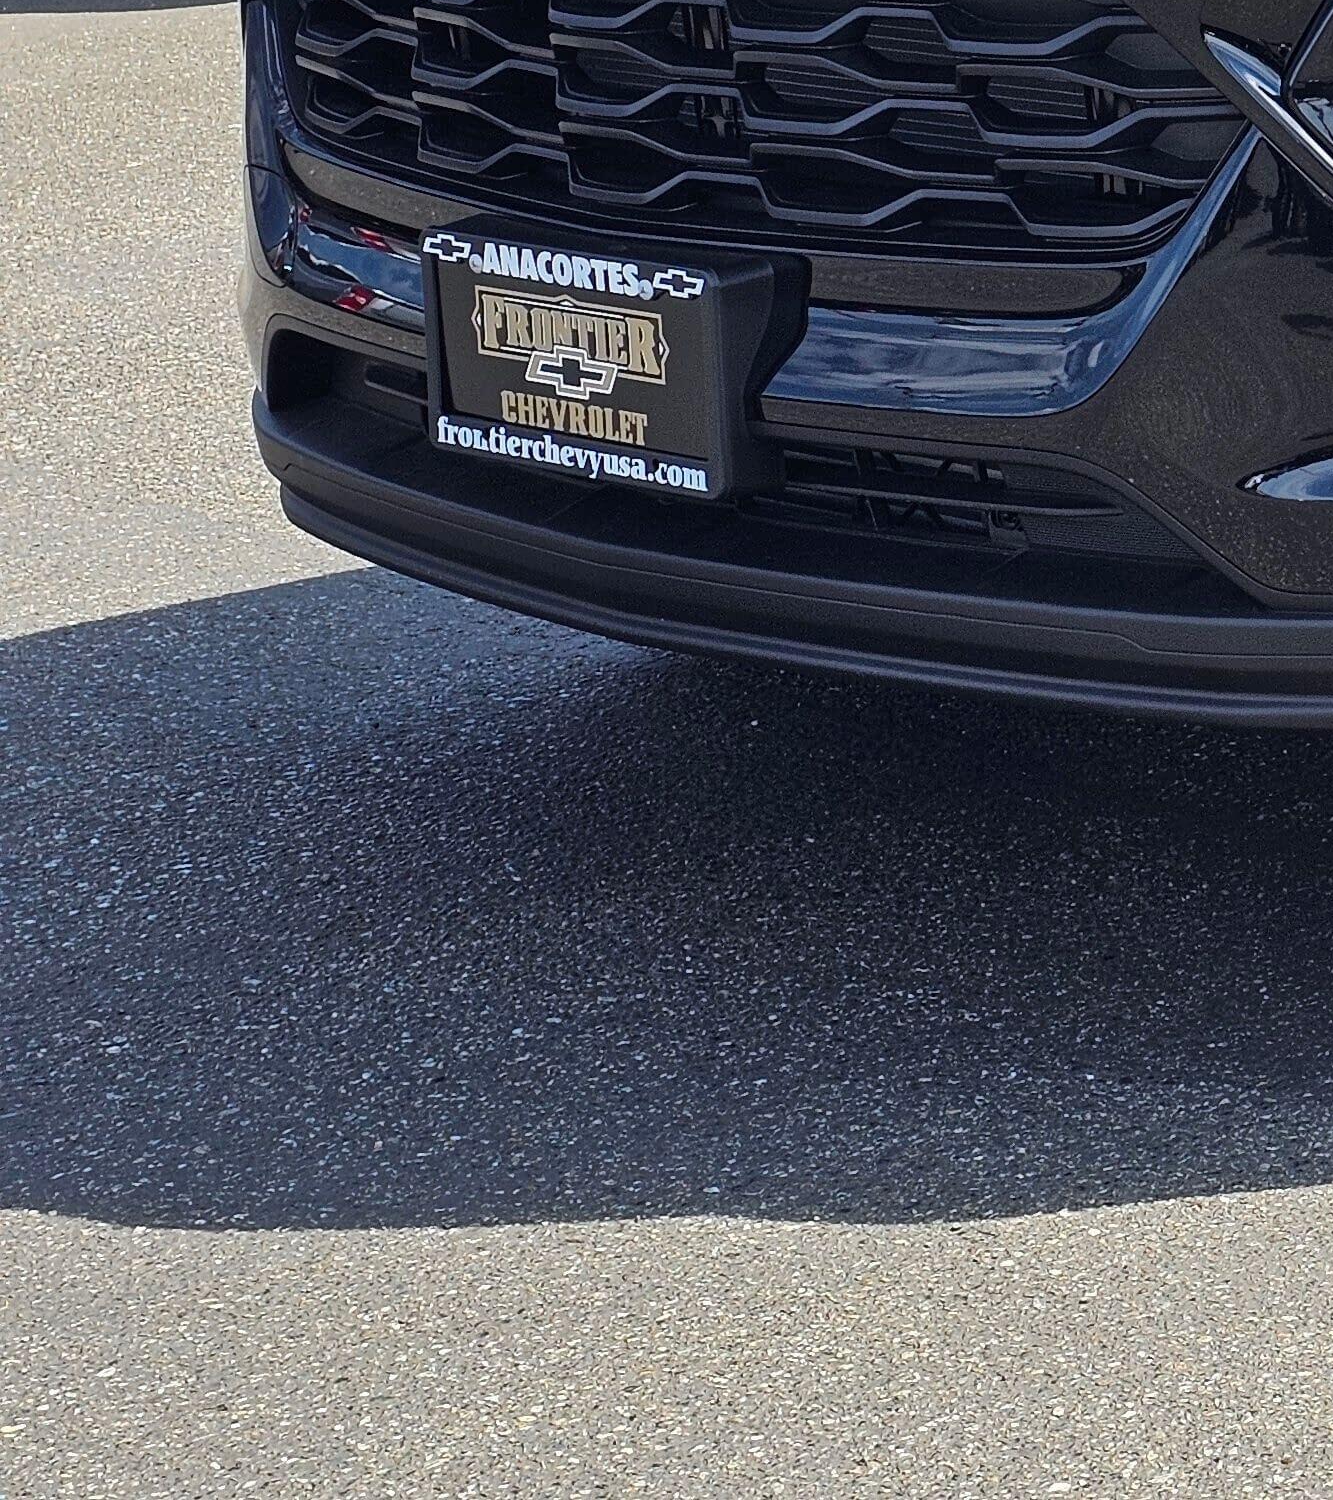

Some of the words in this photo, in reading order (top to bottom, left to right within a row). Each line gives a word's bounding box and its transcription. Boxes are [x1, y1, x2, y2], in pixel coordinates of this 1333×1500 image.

[482, 242, 641, 297] ANACORTES
[481, 294, 661, 376] FRONTIER
[500, 390, 649, 447] CHEVROLET
